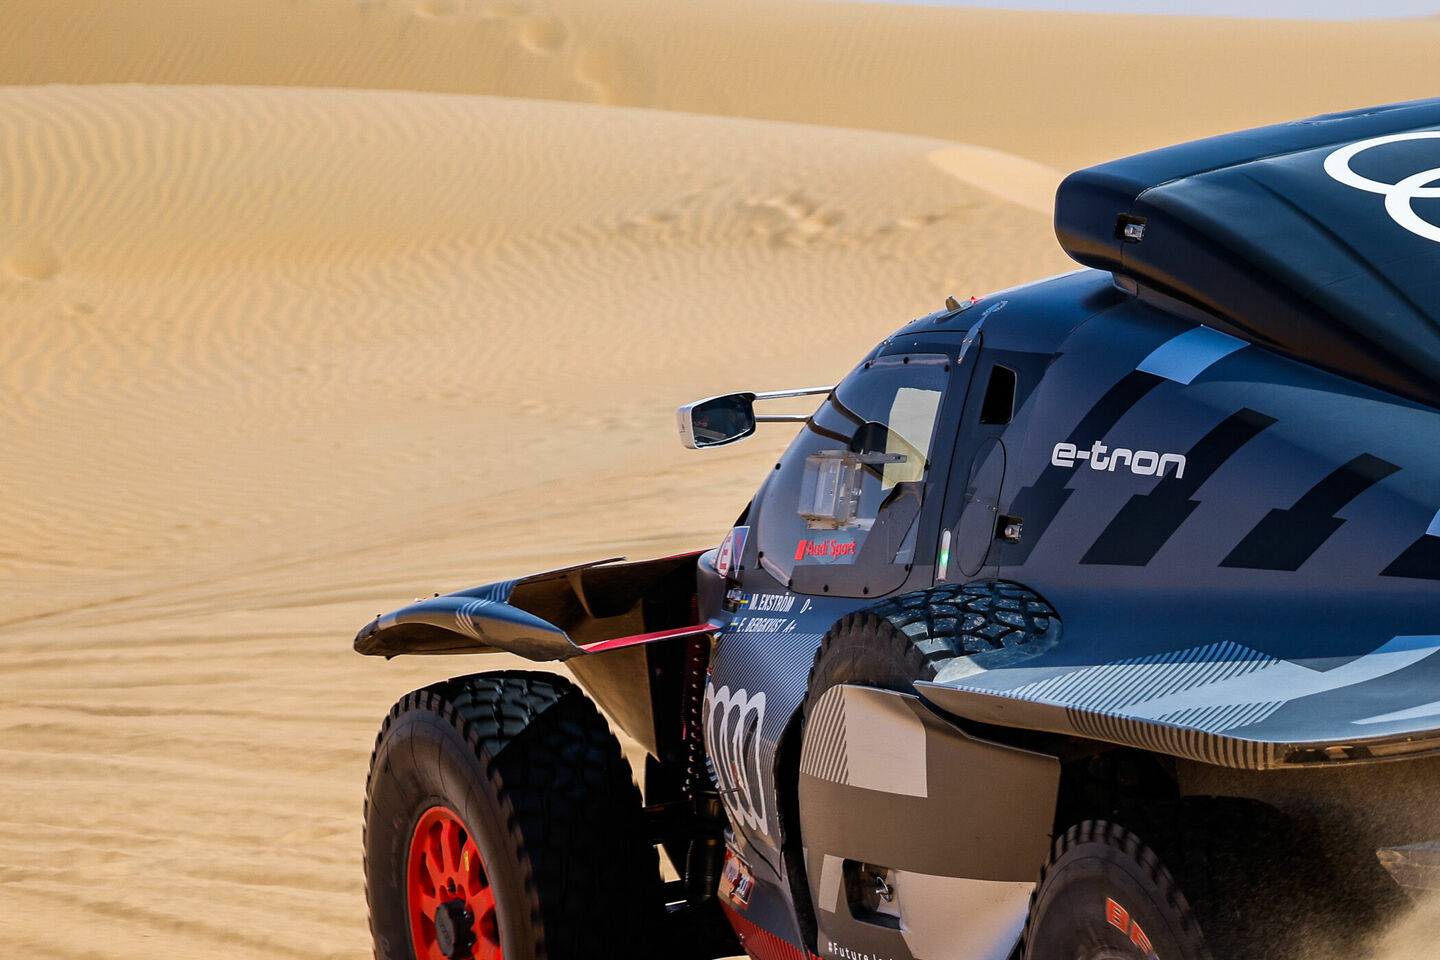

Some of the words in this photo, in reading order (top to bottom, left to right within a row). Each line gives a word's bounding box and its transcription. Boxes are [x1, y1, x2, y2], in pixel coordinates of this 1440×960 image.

[1051, 440, 1187, 479] e-tron
[806, 540, 828, 556] Audi
[829, 539, 857, 559] Sport
[758, 592, 796, 613] EKSTRÖM
